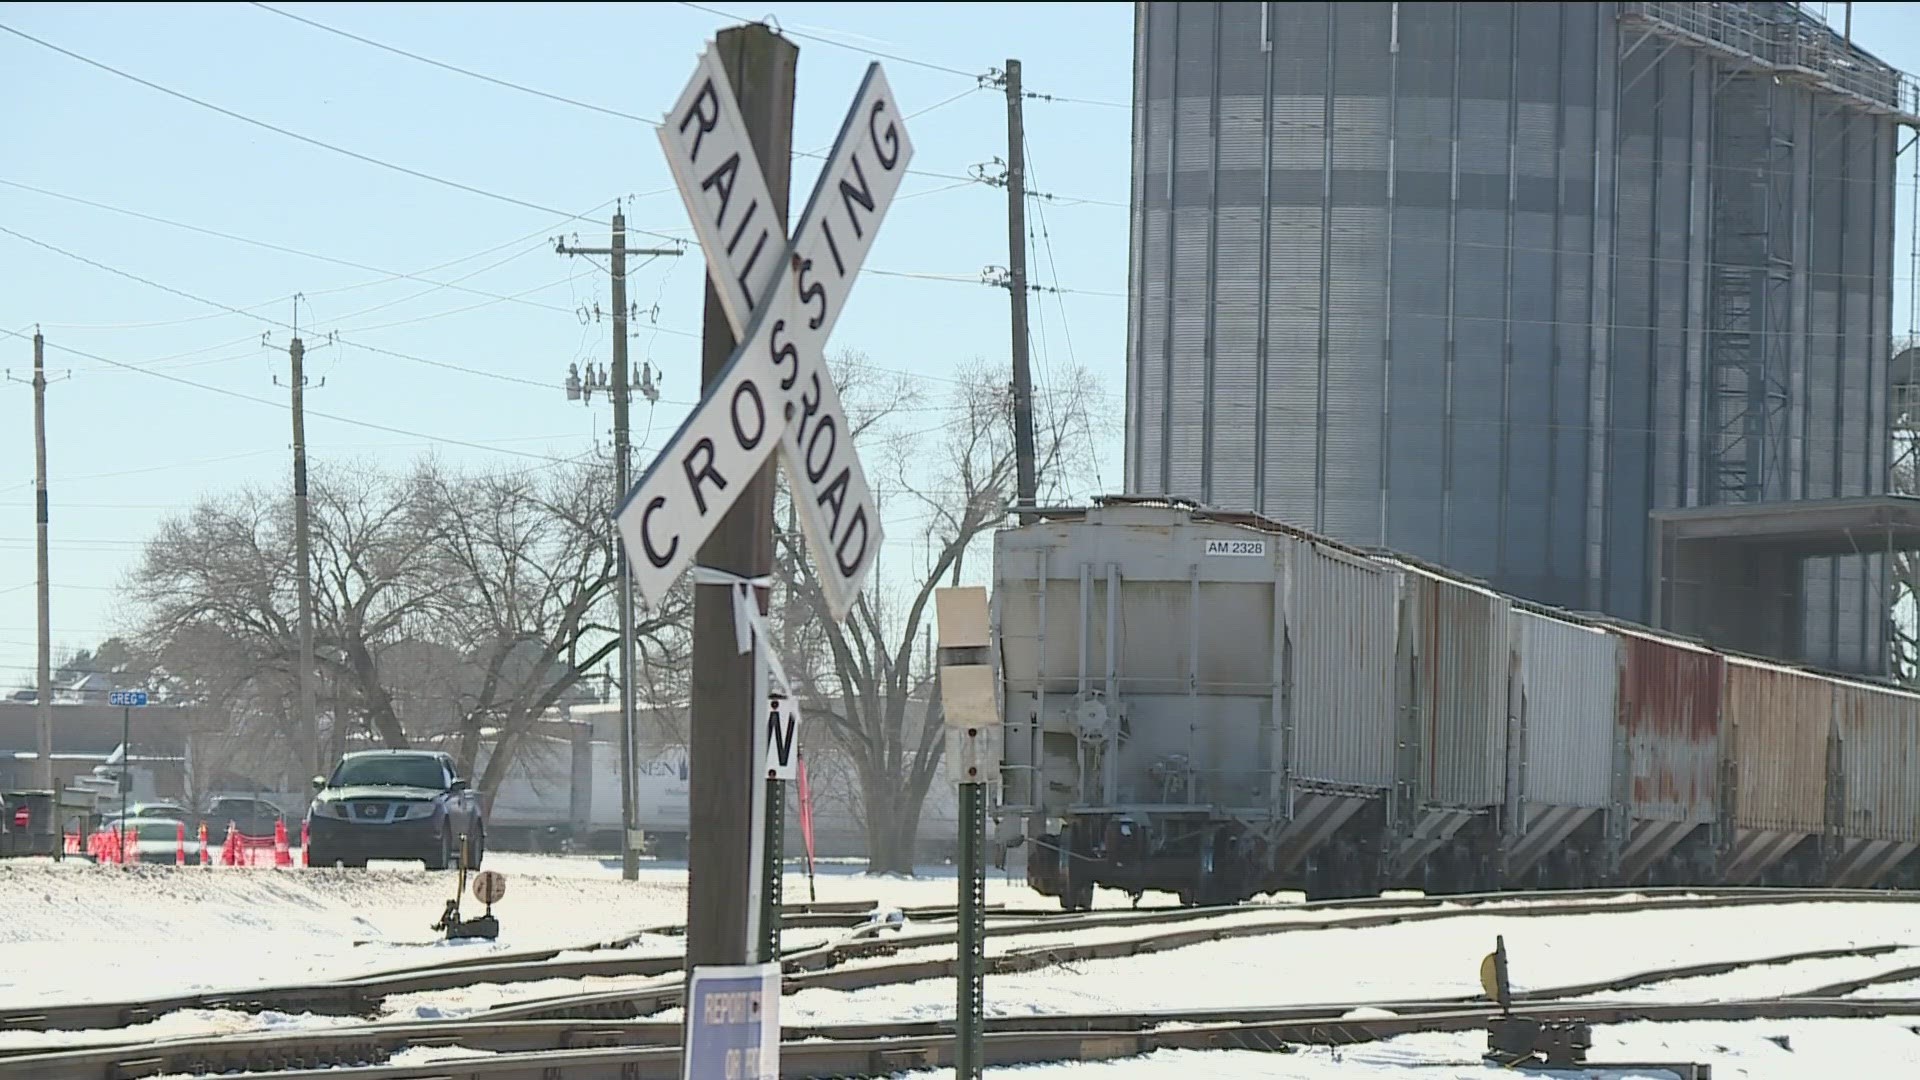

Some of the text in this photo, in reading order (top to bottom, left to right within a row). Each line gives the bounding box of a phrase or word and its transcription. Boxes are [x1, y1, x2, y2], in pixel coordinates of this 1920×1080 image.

[680, 77, 769, 311] RAIL
[639, 99, 902, 569] CROSSING
[1208, 542, 1263, 554] AM 2328
